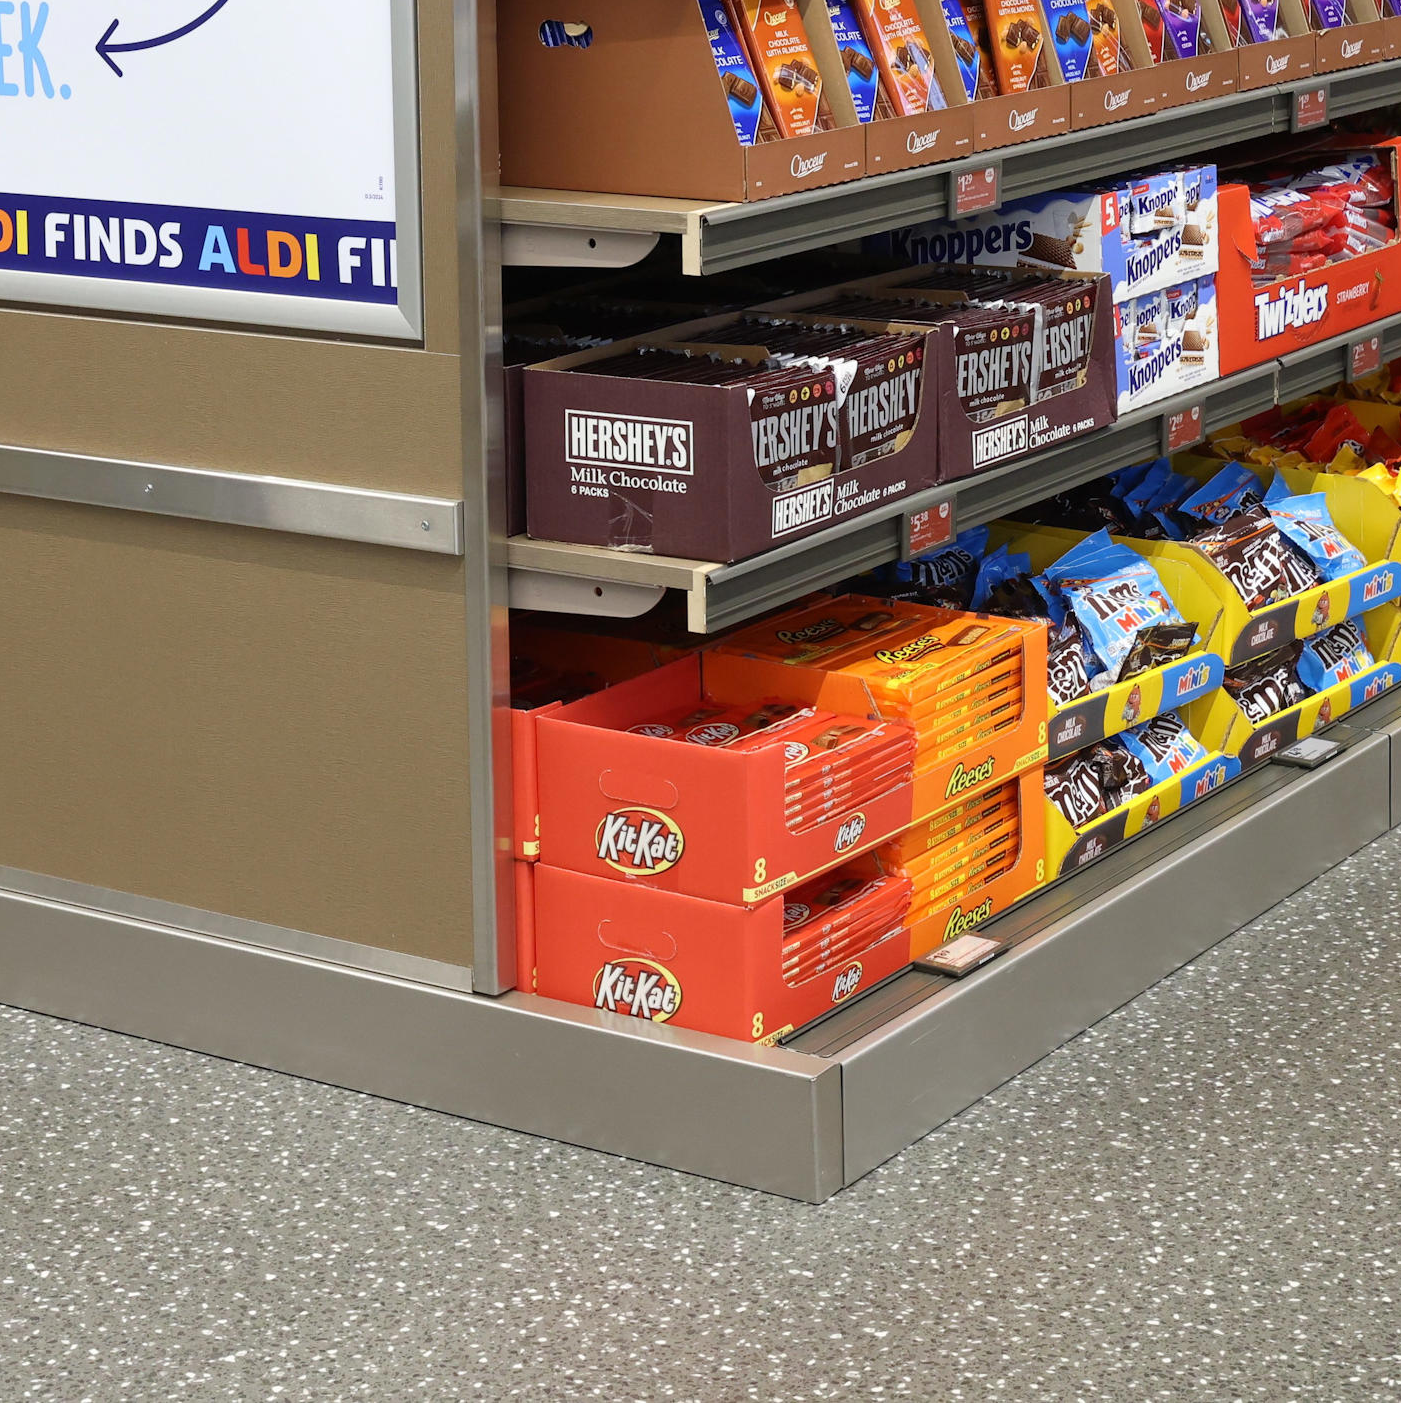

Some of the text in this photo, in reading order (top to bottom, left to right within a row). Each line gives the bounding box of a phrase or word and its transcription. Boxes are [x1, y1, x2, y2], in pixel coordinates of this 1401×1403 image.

[767, 46, 807, 57] WITH ALMONDS
[768, 38, 801, 48] CHOCOLATE
[1105, 89, 1132, 111] Choceur
[1009, 108, 1038, 131] Choceur
[907, 130, 940, 154] Choceur
[791, 153, 827, 177] Choceur
[44, 212, 182, 268] FINDS
[198, 225, 320, 281] ALDI
[338, 236, 397, 288] FI
[891, 220, 1033, 266] Knoppers
[1127, 229, 1182, 286] Knoppers
[1336, 281, 1370, 304] STRAWBERRY
[1254, 279, 1328, 341] Twizzlers
[1129, 336, 1182, 396] Knoppers
[848, 369, 921, 440] HERSHEY'
[1029, 424, 1071, 449] Chocolate
[1077, 417, 1095, 432] PACKS
[1030, 415, 1050, 434] Milk
[571, 416, 687, 468] HERSHEY'S
[976, 419, 1026, 463] HERSHEY'S
[571, 467, 687, 494] Milk Chocolate
[571, 484, 609, 498] 6 PACKS
[836, 479, 860, 501] Milk
[775, 482, 833, 533] HERSHEY'S
[834, 490, 881, 516] Chocolate
[888, 480, 906, 495] PACKS
[1251, 629, 1274, 647] CHOCOLATE
[1258, 622, 1269, 633] MILK
[875, 634, 941, 665] Reese's
[1037, 721, 1047, 745] 8
[1057, 725, 1083, 745] CHOCOLATE
[1065, 716, 1076, 728] MILK
[945, 755, 995, 799] Reese's
[599, 812, 680, 870] KitKat
[835, 818, 866, 853] KitKat
[754, 857, 767, 884] 8
[1035, 858, 1046, 883] 8
[943, 898, 993, 942] Reese's
[596, 962, 679, 1020] KitKat
